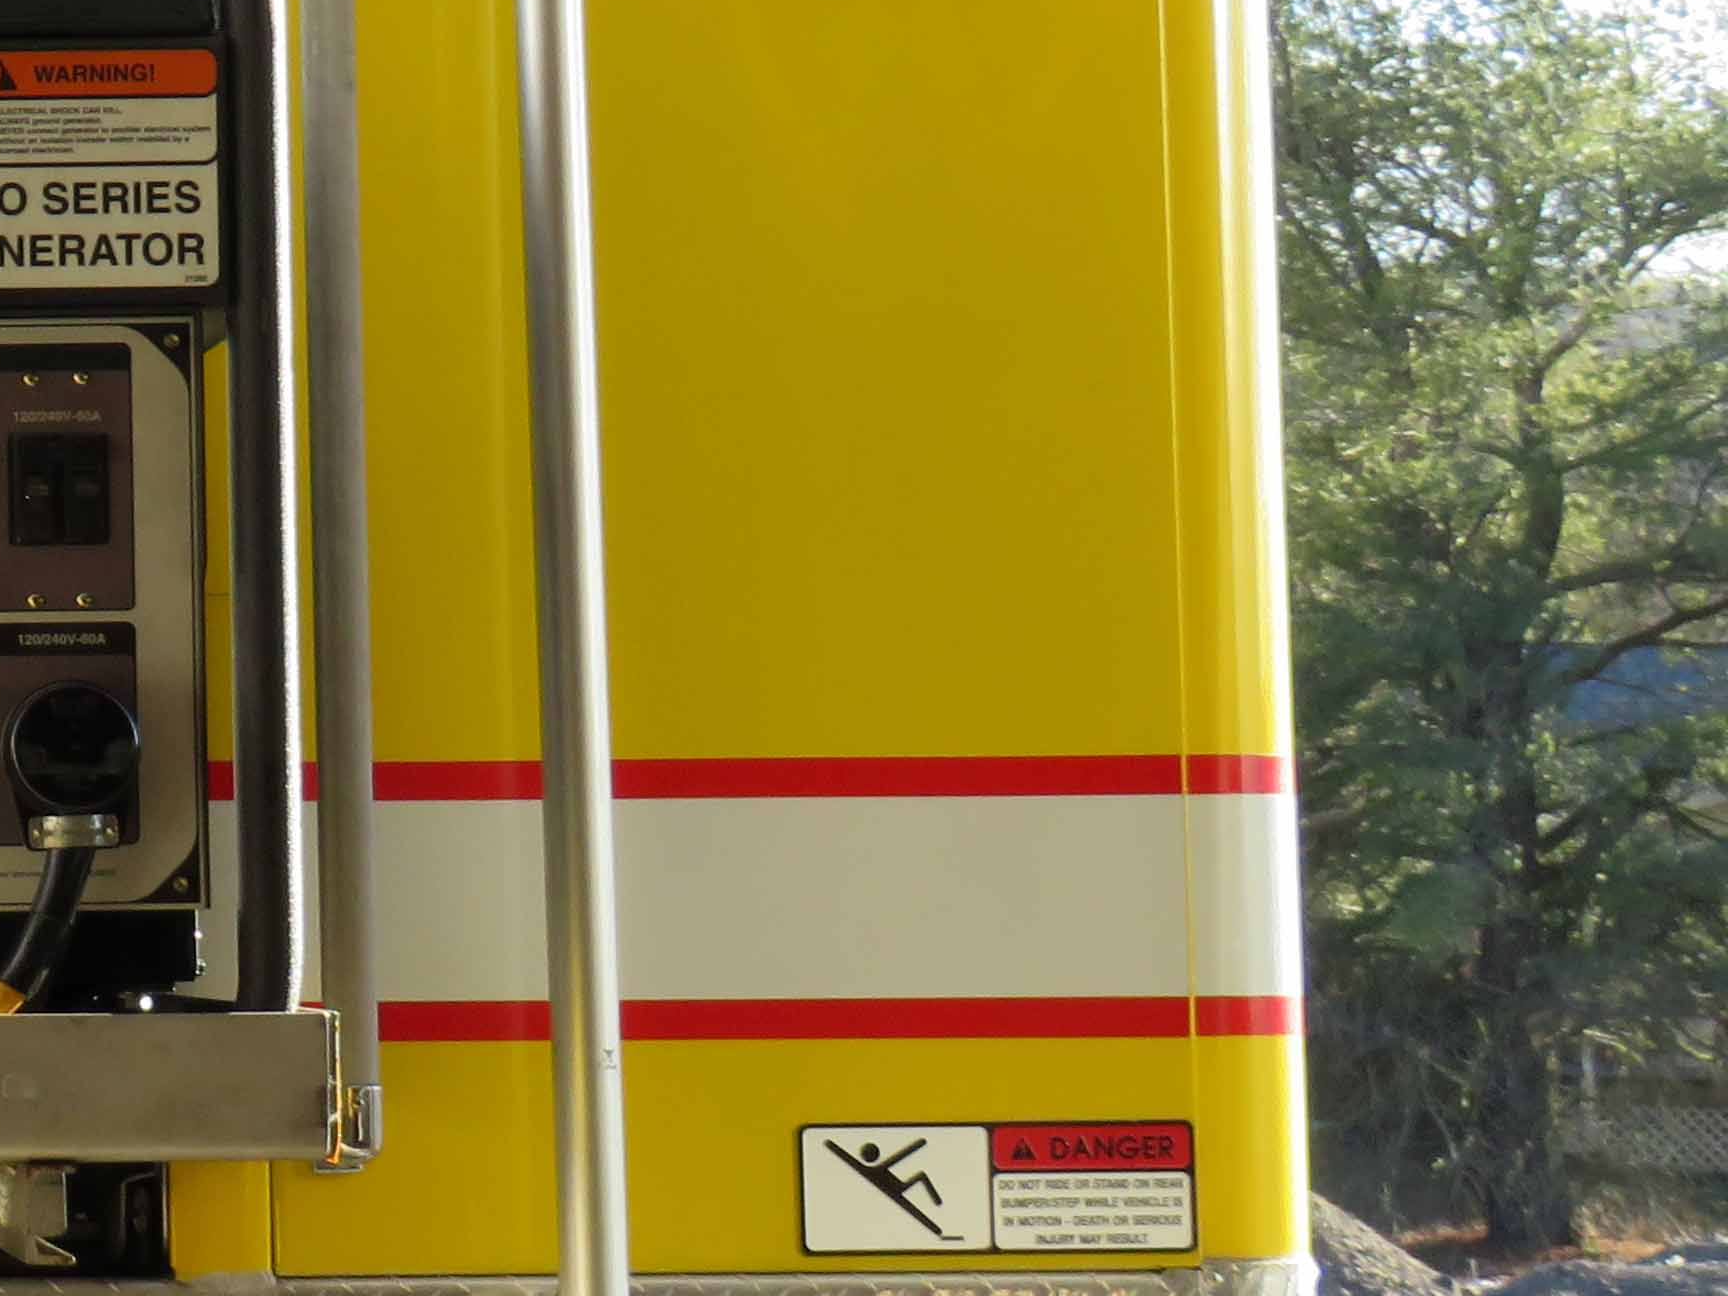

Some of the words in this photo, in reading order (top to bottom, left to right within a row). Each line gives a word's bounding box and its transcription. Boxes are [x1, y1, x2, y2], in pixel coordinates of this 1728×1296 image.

[34, 63, 156, 83] WARNING!
[43, 181, 201, 215] SERIES
[1050, 1136, 1173, 1160] DANGER
